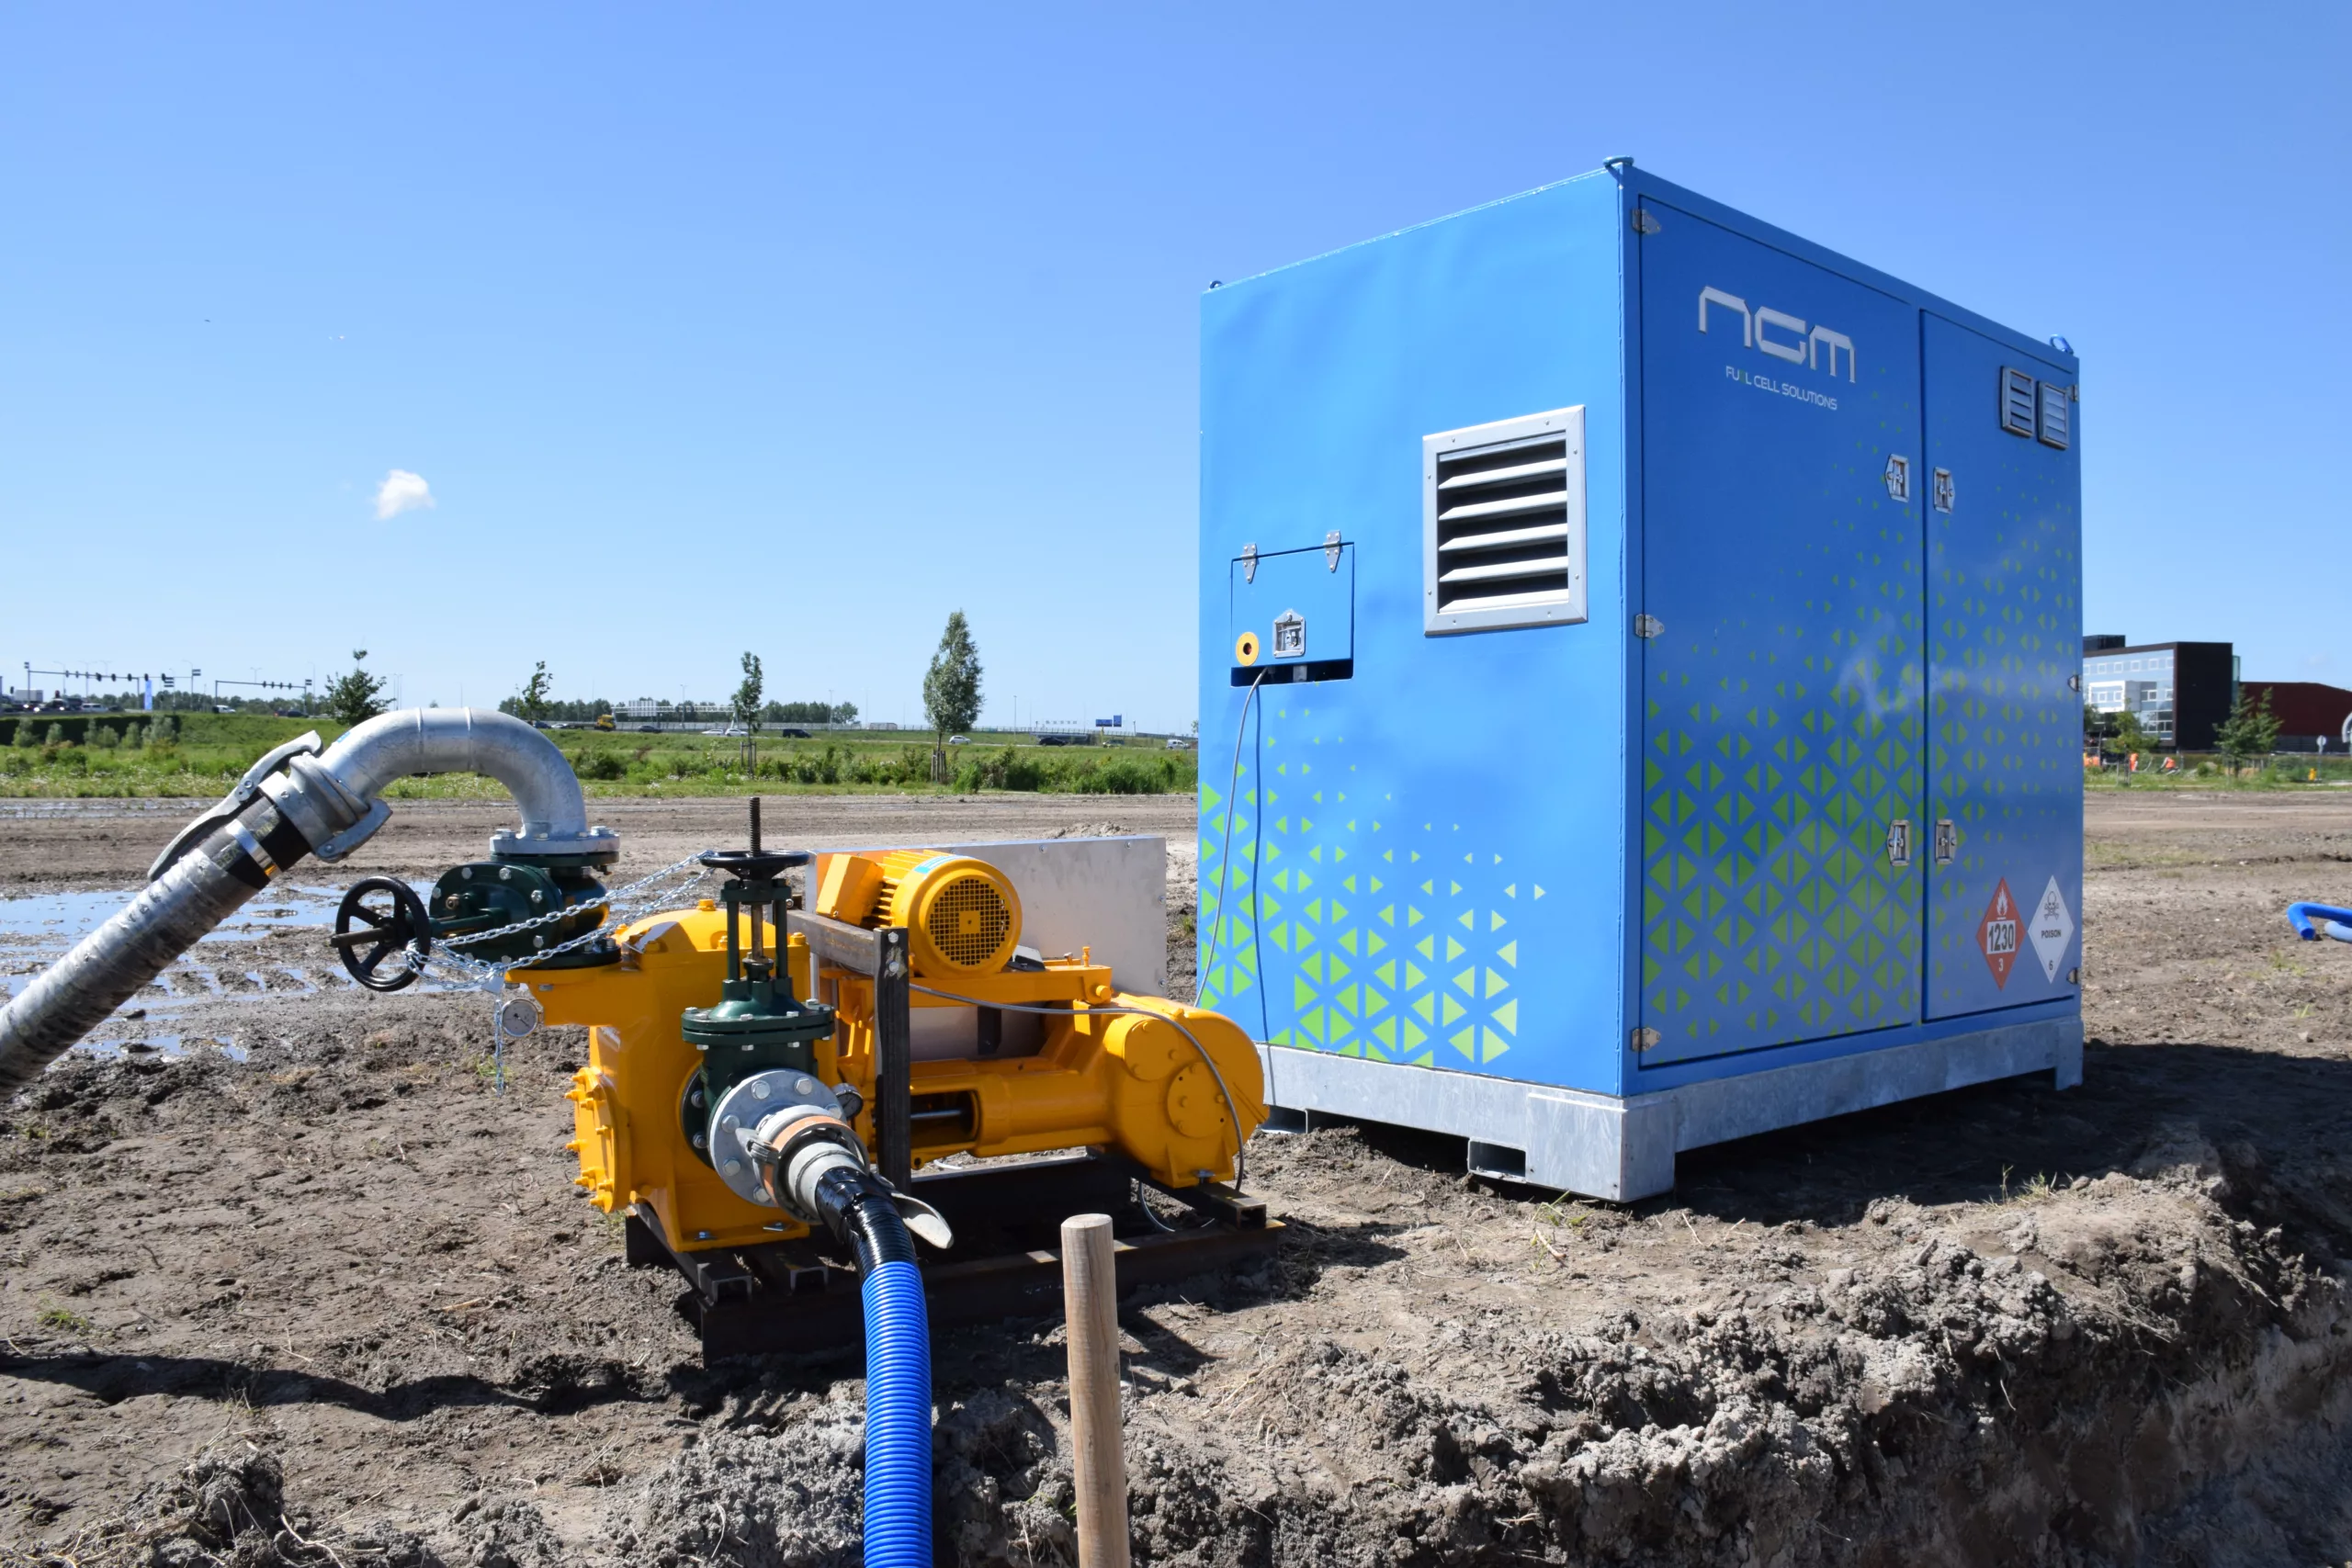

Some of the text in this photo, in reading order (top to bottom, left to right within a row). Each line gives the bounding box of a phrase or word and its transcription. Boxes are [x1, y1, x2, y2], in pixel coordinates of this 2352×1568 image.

[1726, 366, 1838, 410] FUL CELL SOLUTIONS
[1989, 923, 2015, 952] 1230
[2041, 929, 2062, 939] POISON
[1998, 957, 2004, 972] 3
[2049, 959, 2053, 971] 6
